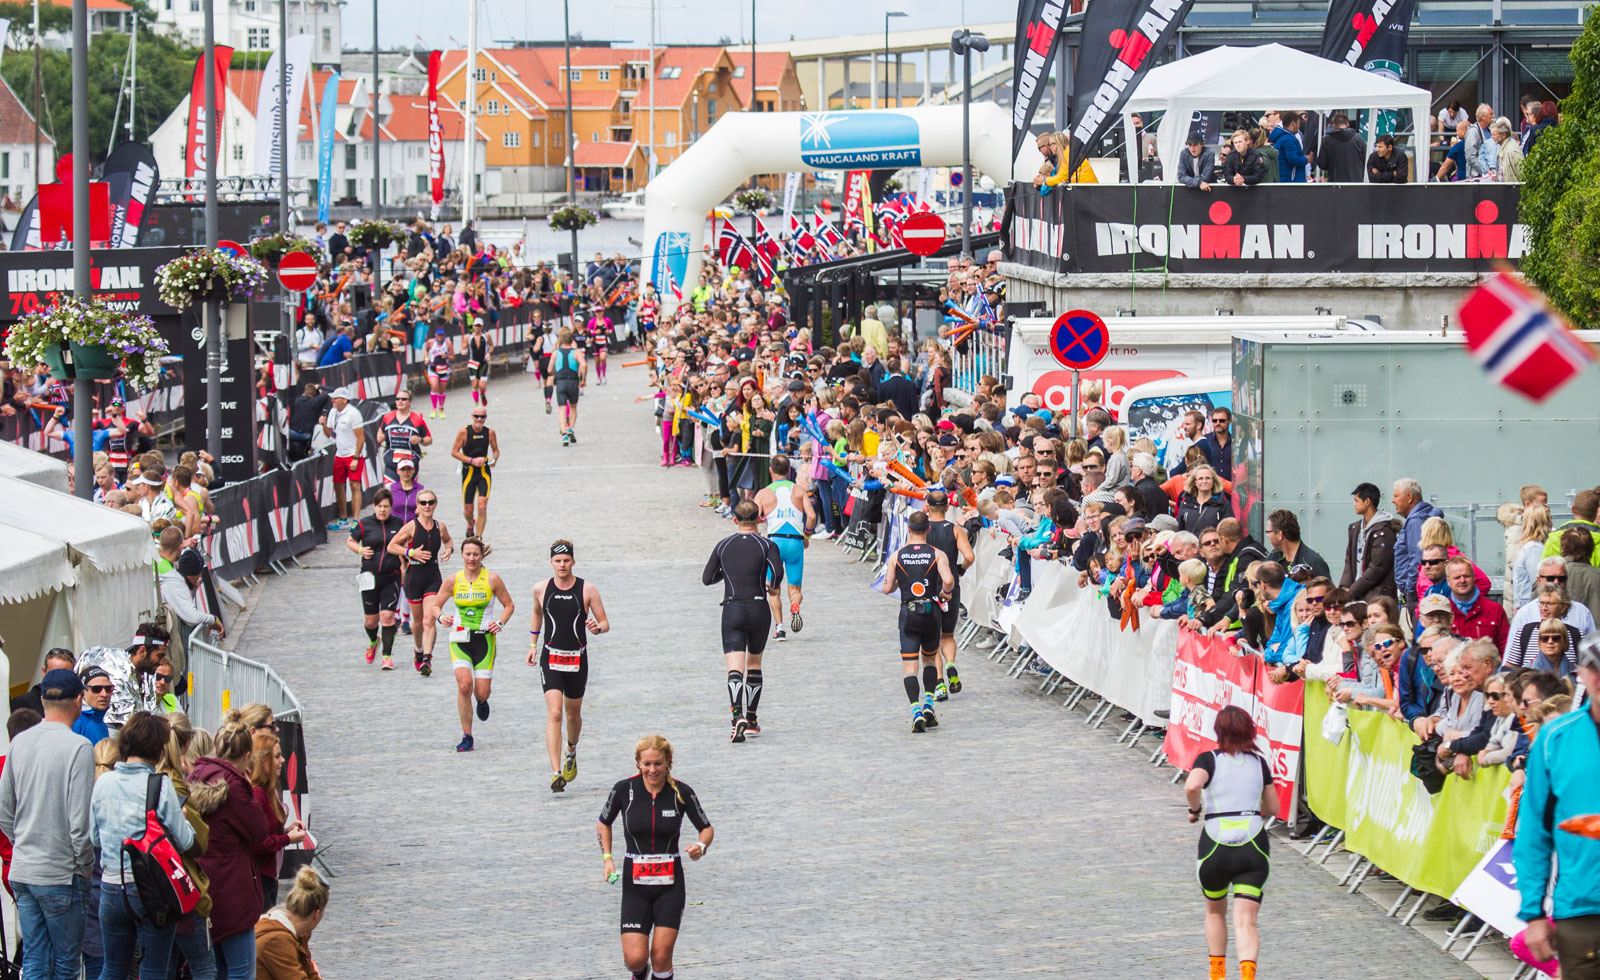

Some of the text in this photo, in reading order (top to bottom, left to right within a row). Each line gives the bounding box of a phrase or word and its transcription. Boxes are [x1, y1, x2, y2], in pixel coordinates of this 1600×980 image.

[1014, 0, 1066, 130] IRONMA
[809, 150, 917, 165] HAUGALAND KRAFT
[1094, 200, 1305, 259] IRONMAN
[1358, 200, 1537, 259] IRONMA
[107, 301, 141, 311] RWAY
[924, 579, 929, 587] 3
[638, 863, 670, 874] 3121
